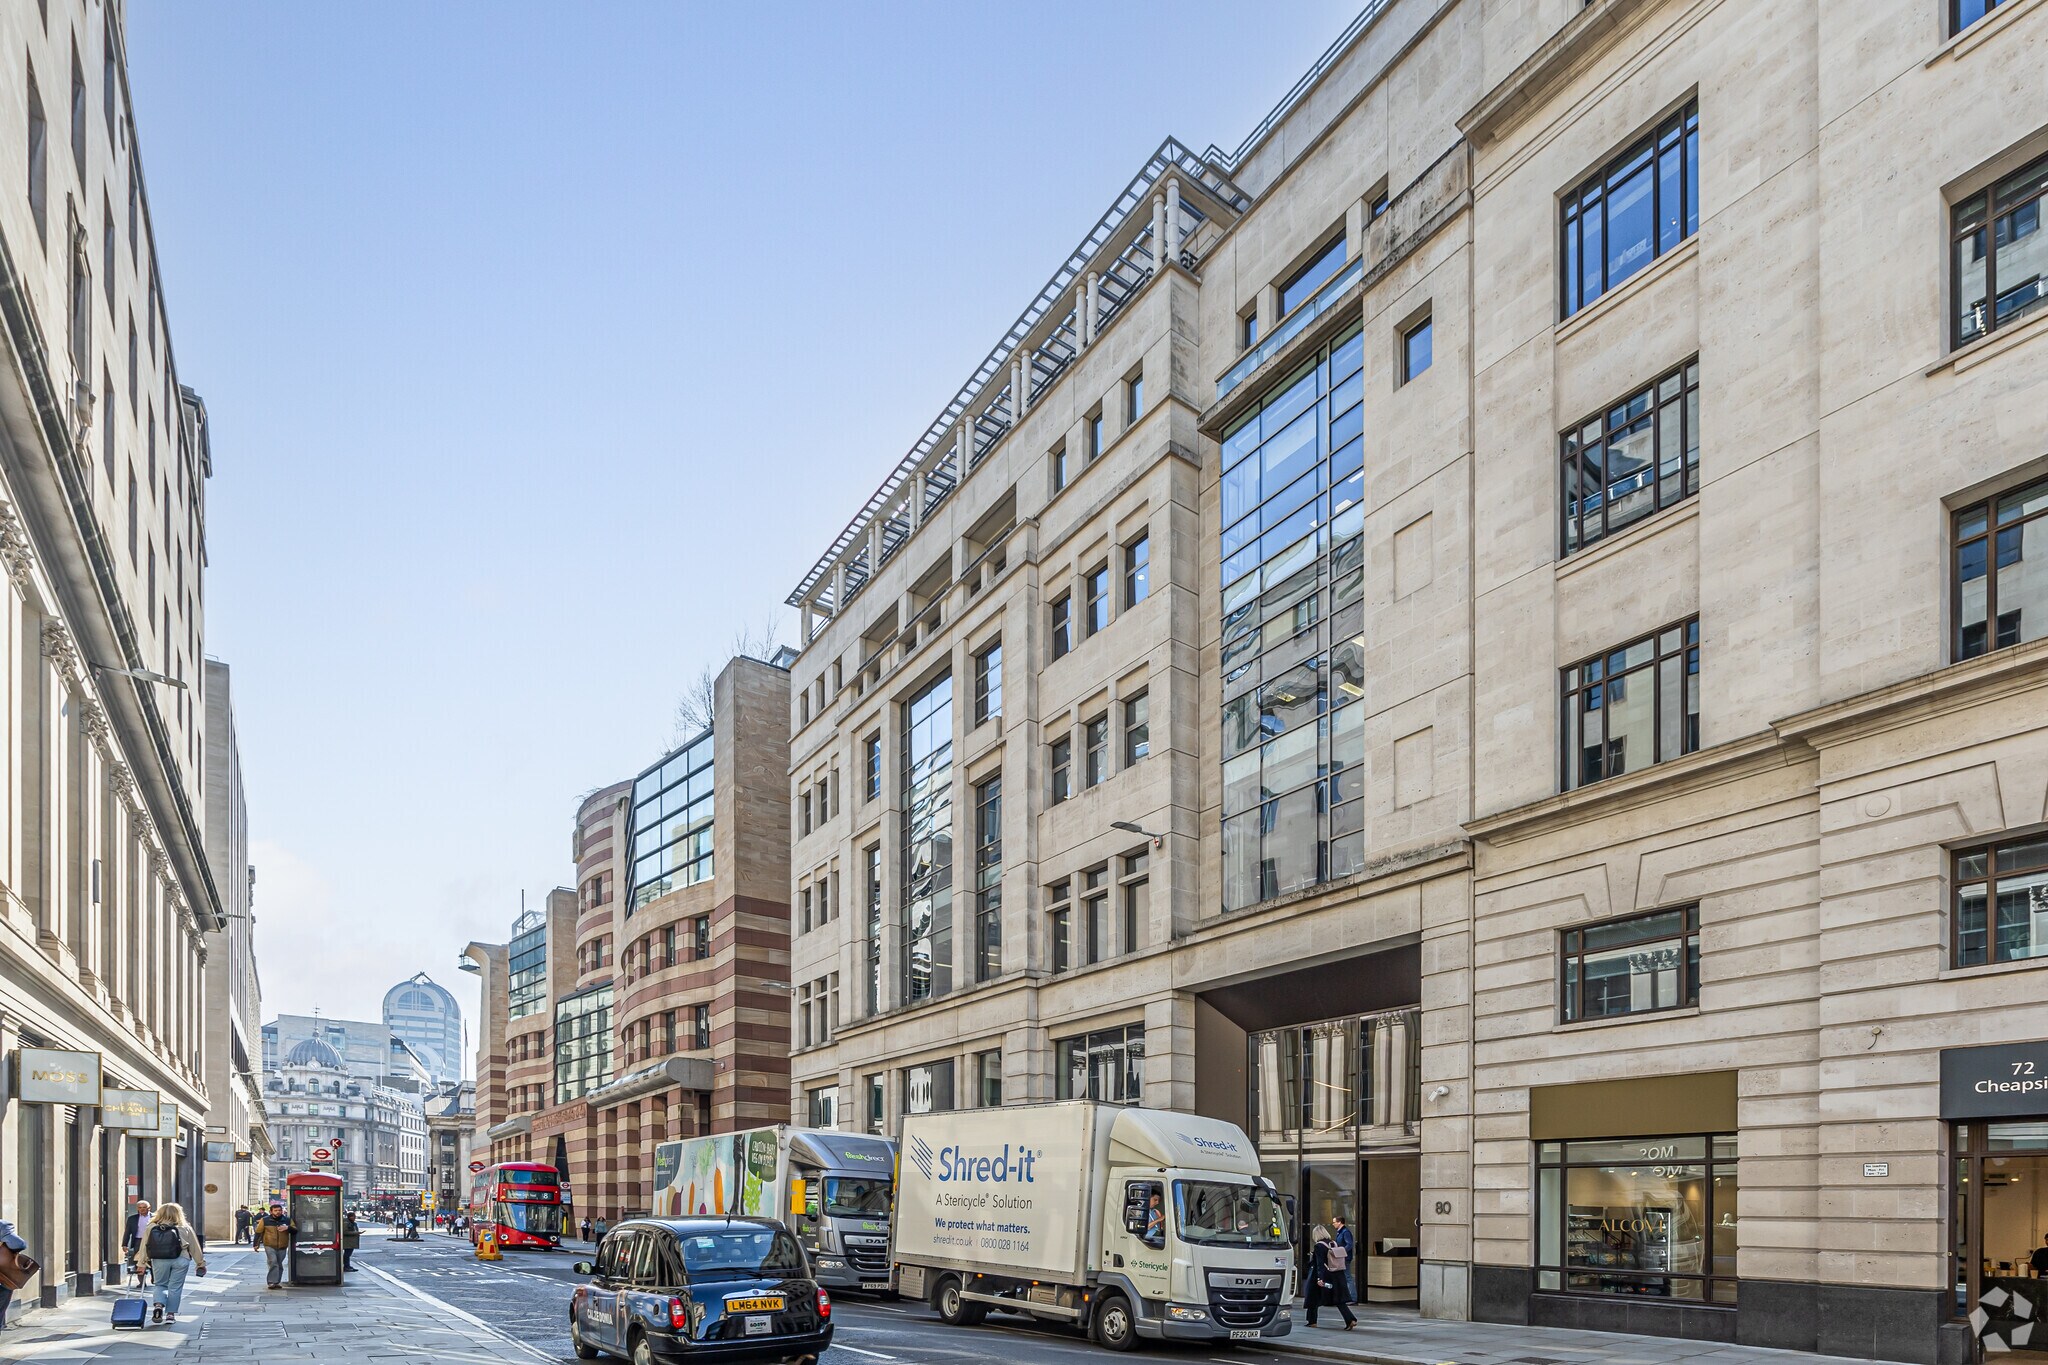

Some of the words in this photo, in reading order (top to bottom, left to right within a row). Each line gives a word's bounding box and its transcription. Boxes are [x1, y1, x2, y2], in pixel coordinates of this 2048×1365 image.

[2011, 1062, 2035, 1076] 72
[32, 1070, 89, 1085] MOSS
[332, 1139, 339, 1147] K
[1194, 1137, 1238, 1152] Shred-it
[936, 1194, 942, 1206] A
[992, 1194, 1033, 1209] Solution
[1435, 1201, 1452, 1215] 80
[935, 1217, 946, 1228] We
[948, 1220, 974, 1231] protect
[976, 1220, 995, 1231] what
[997, 1223, 1031, 1234] matters.
[933, 1235, 973, 1247] shredit.co.uk
[980, 1238, 997, 1249] 0800
[998, 1239, 1011, 1250] 028
[1013, 1240, 1029, 1251] 1164
[731, 1301, 758, 1310] LM64
[760, 1299, 780, 1309] NVK
[587, 1308, 614, 1325] CALZEDONIA
